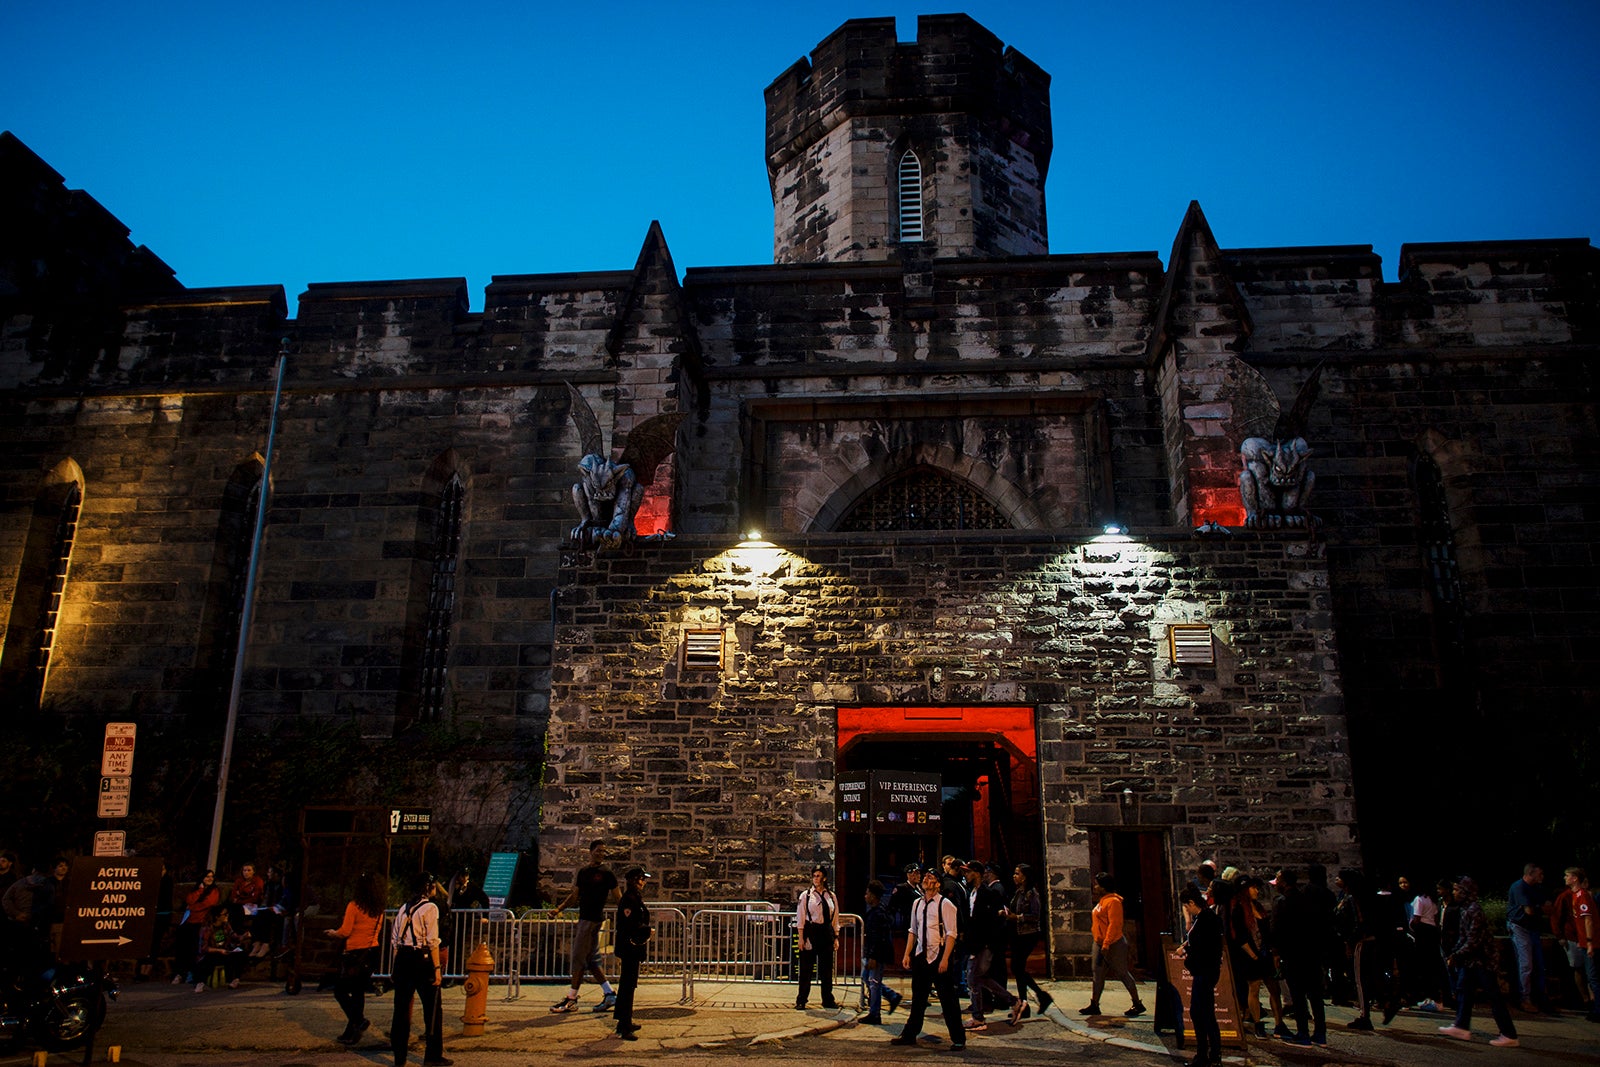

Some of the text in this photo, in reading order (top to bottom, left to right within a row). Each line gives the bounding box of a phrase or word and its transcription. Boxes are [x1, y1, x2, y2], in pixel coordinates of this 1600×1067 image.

[114, 737, 126, 746] NO
[108, 760, 128, 768] TIME
[103, 779, 109, 790] 3
[879, 781, 938, 793] VIP EXPERIENCES
[890, 793, 928, 804] ENTRANCE
[97, 867, 140, 878] ACTIVE
[90, 880, 142, 891] LOADING
[101, 893, 127, 904] AND
[77, 906, 146, 918] UNLOADING
[94, 920, 126, 931] ONLY
